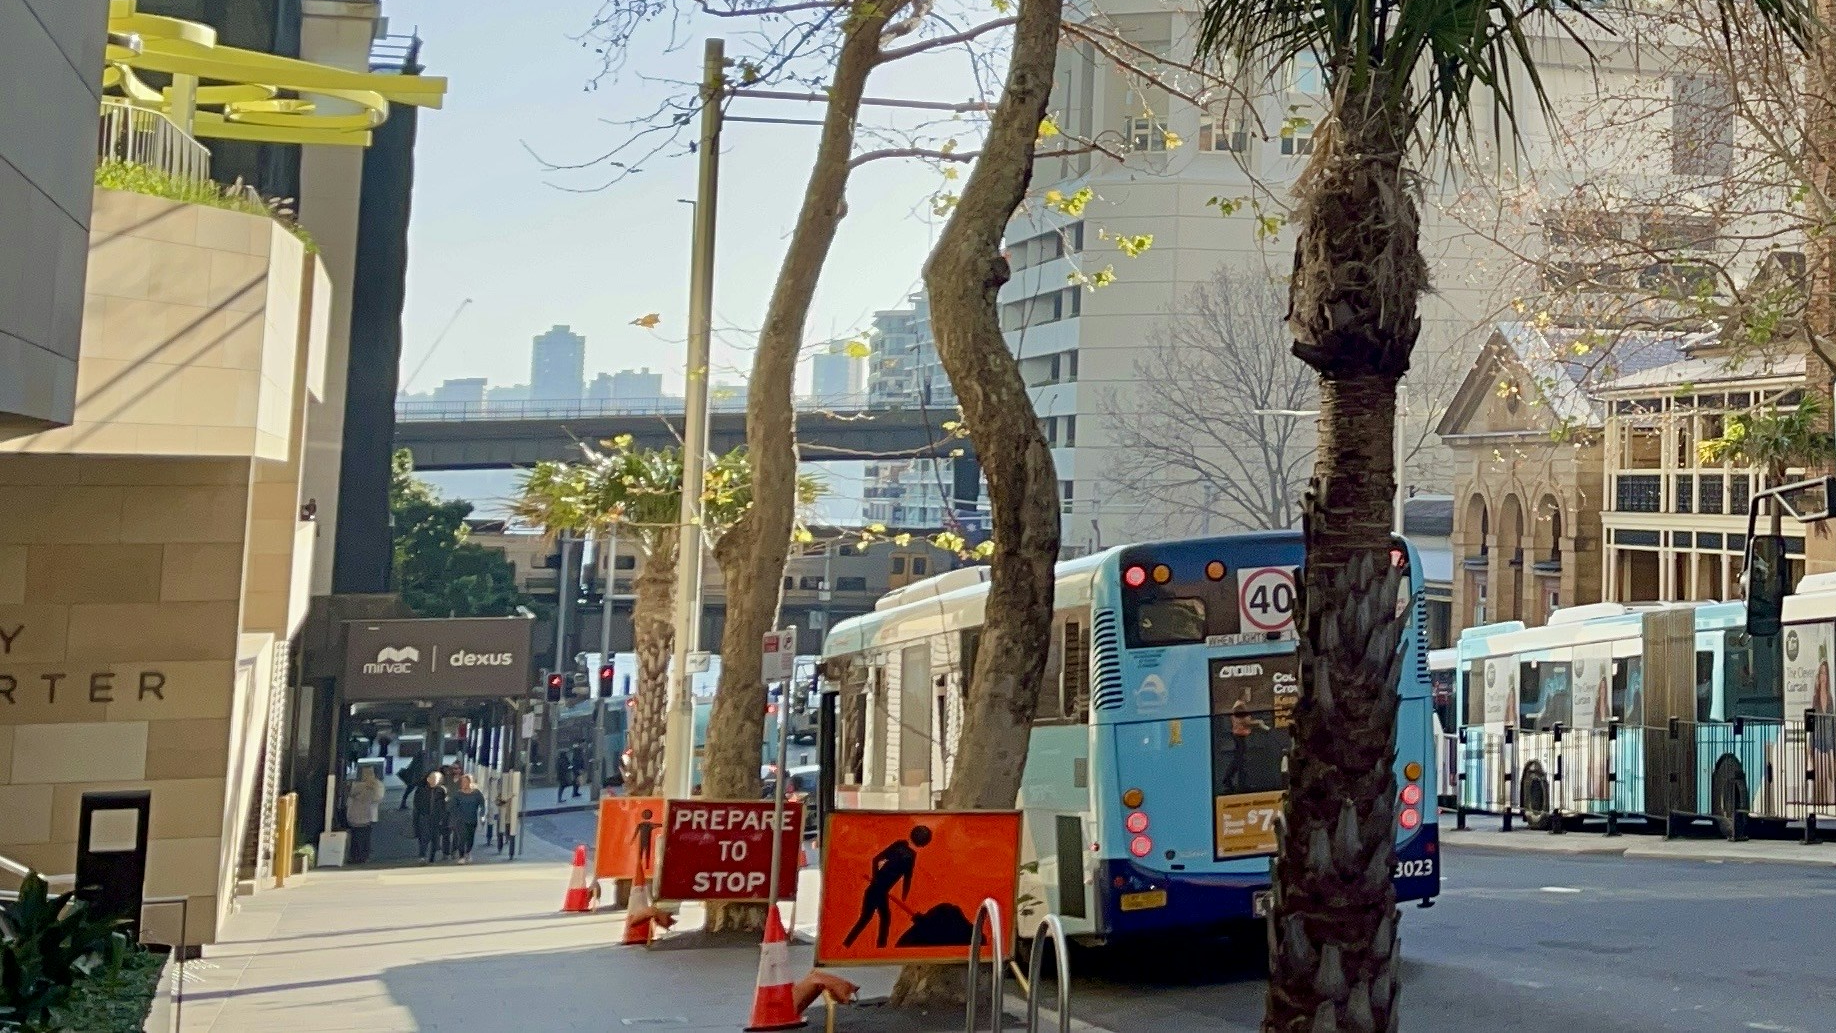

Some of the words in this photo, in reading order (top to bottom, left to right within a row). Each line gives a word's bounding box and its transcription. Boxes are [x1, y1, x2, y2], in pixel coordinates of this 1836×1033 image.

[1249, 583, 1293, 614] 40
[0, 624, 25, 654] Y
[363, 662, 411, 674] mirvac
[450, 649, 513, 667] dexus
[675, 809, 794, 830] PREPARE
[718, 840, 747, 861] TO
[1393, 859, 1433, 878] 3023
[692, 871, 766, 892] STOP
